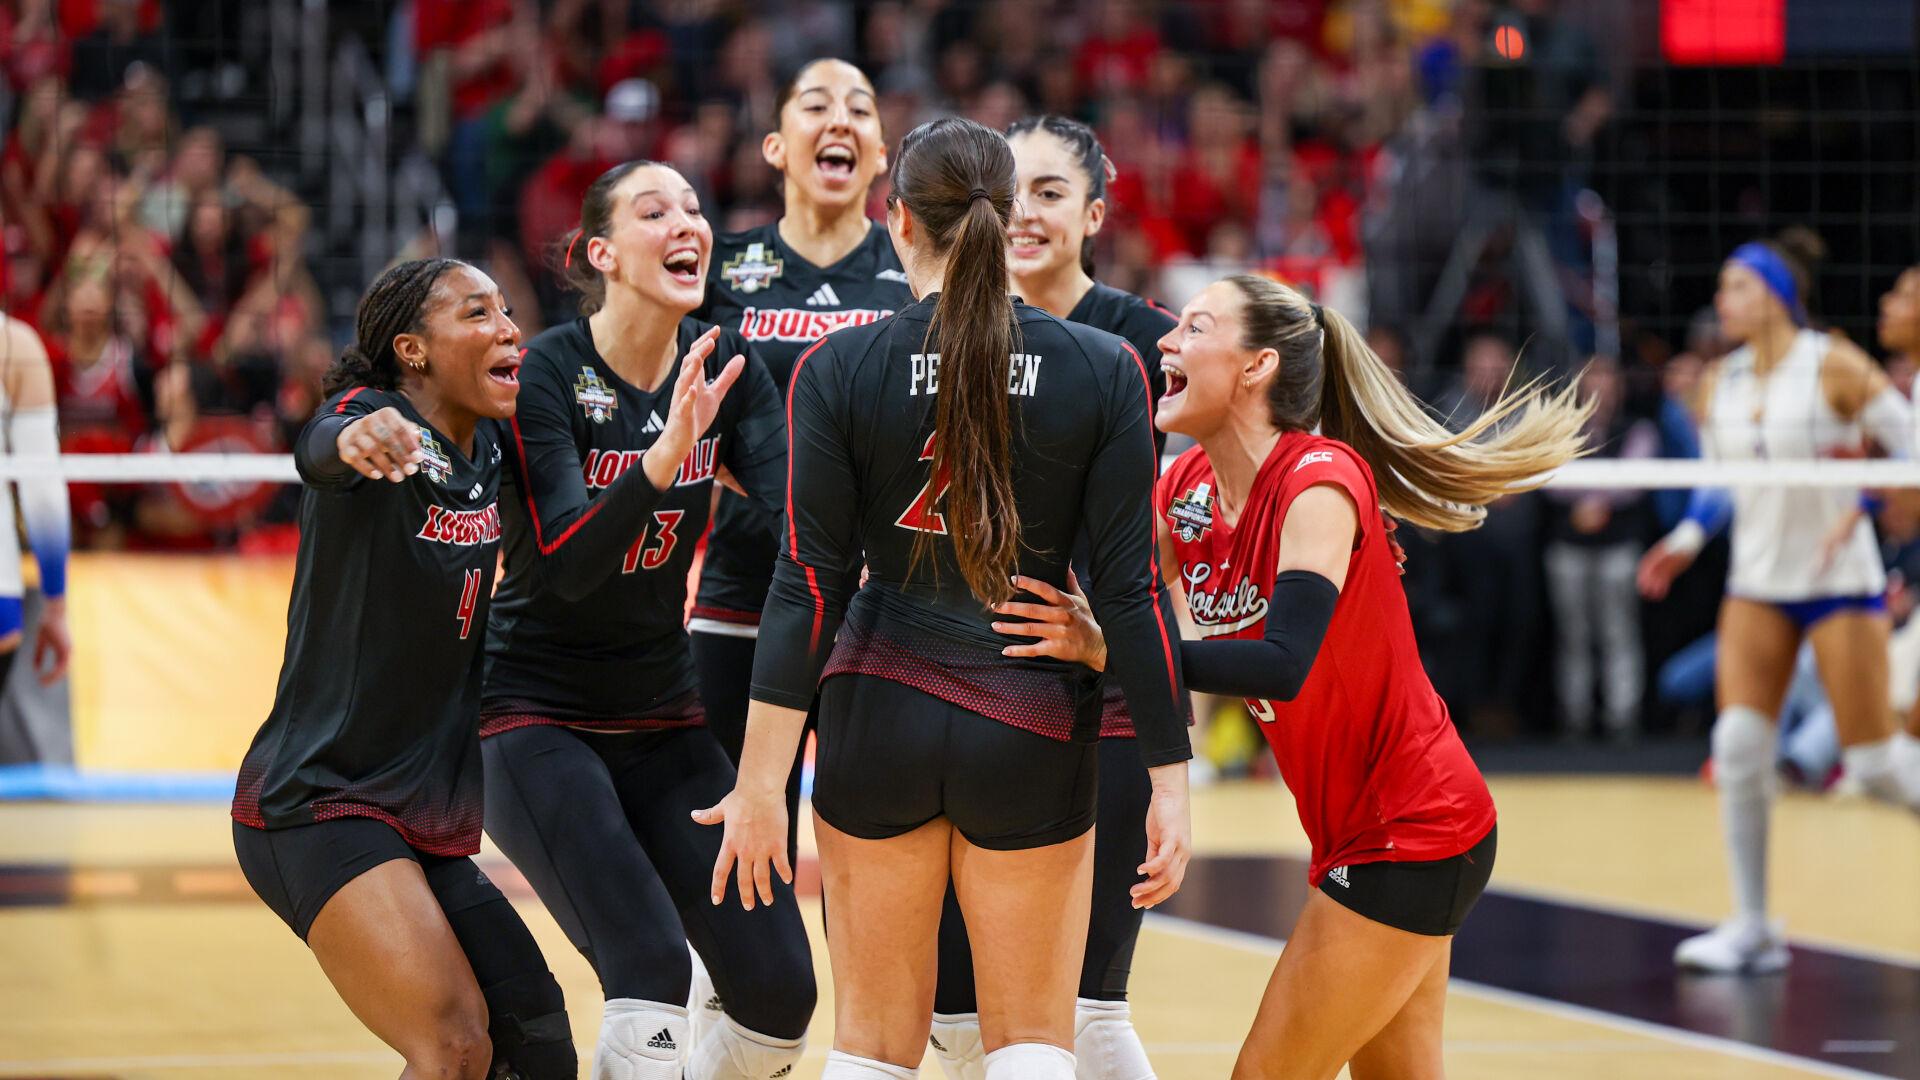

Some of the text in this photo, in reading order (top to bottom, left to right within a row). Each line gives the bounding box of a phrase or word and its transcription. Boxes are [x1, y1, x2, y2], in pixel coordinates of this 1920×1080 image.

[909, 353, 1042, 397] PEEN
[1293, 451, 1334, 473] ACC
[456, 568, 482, 640] 4
[647, 1039, 677, 1050] adidas
